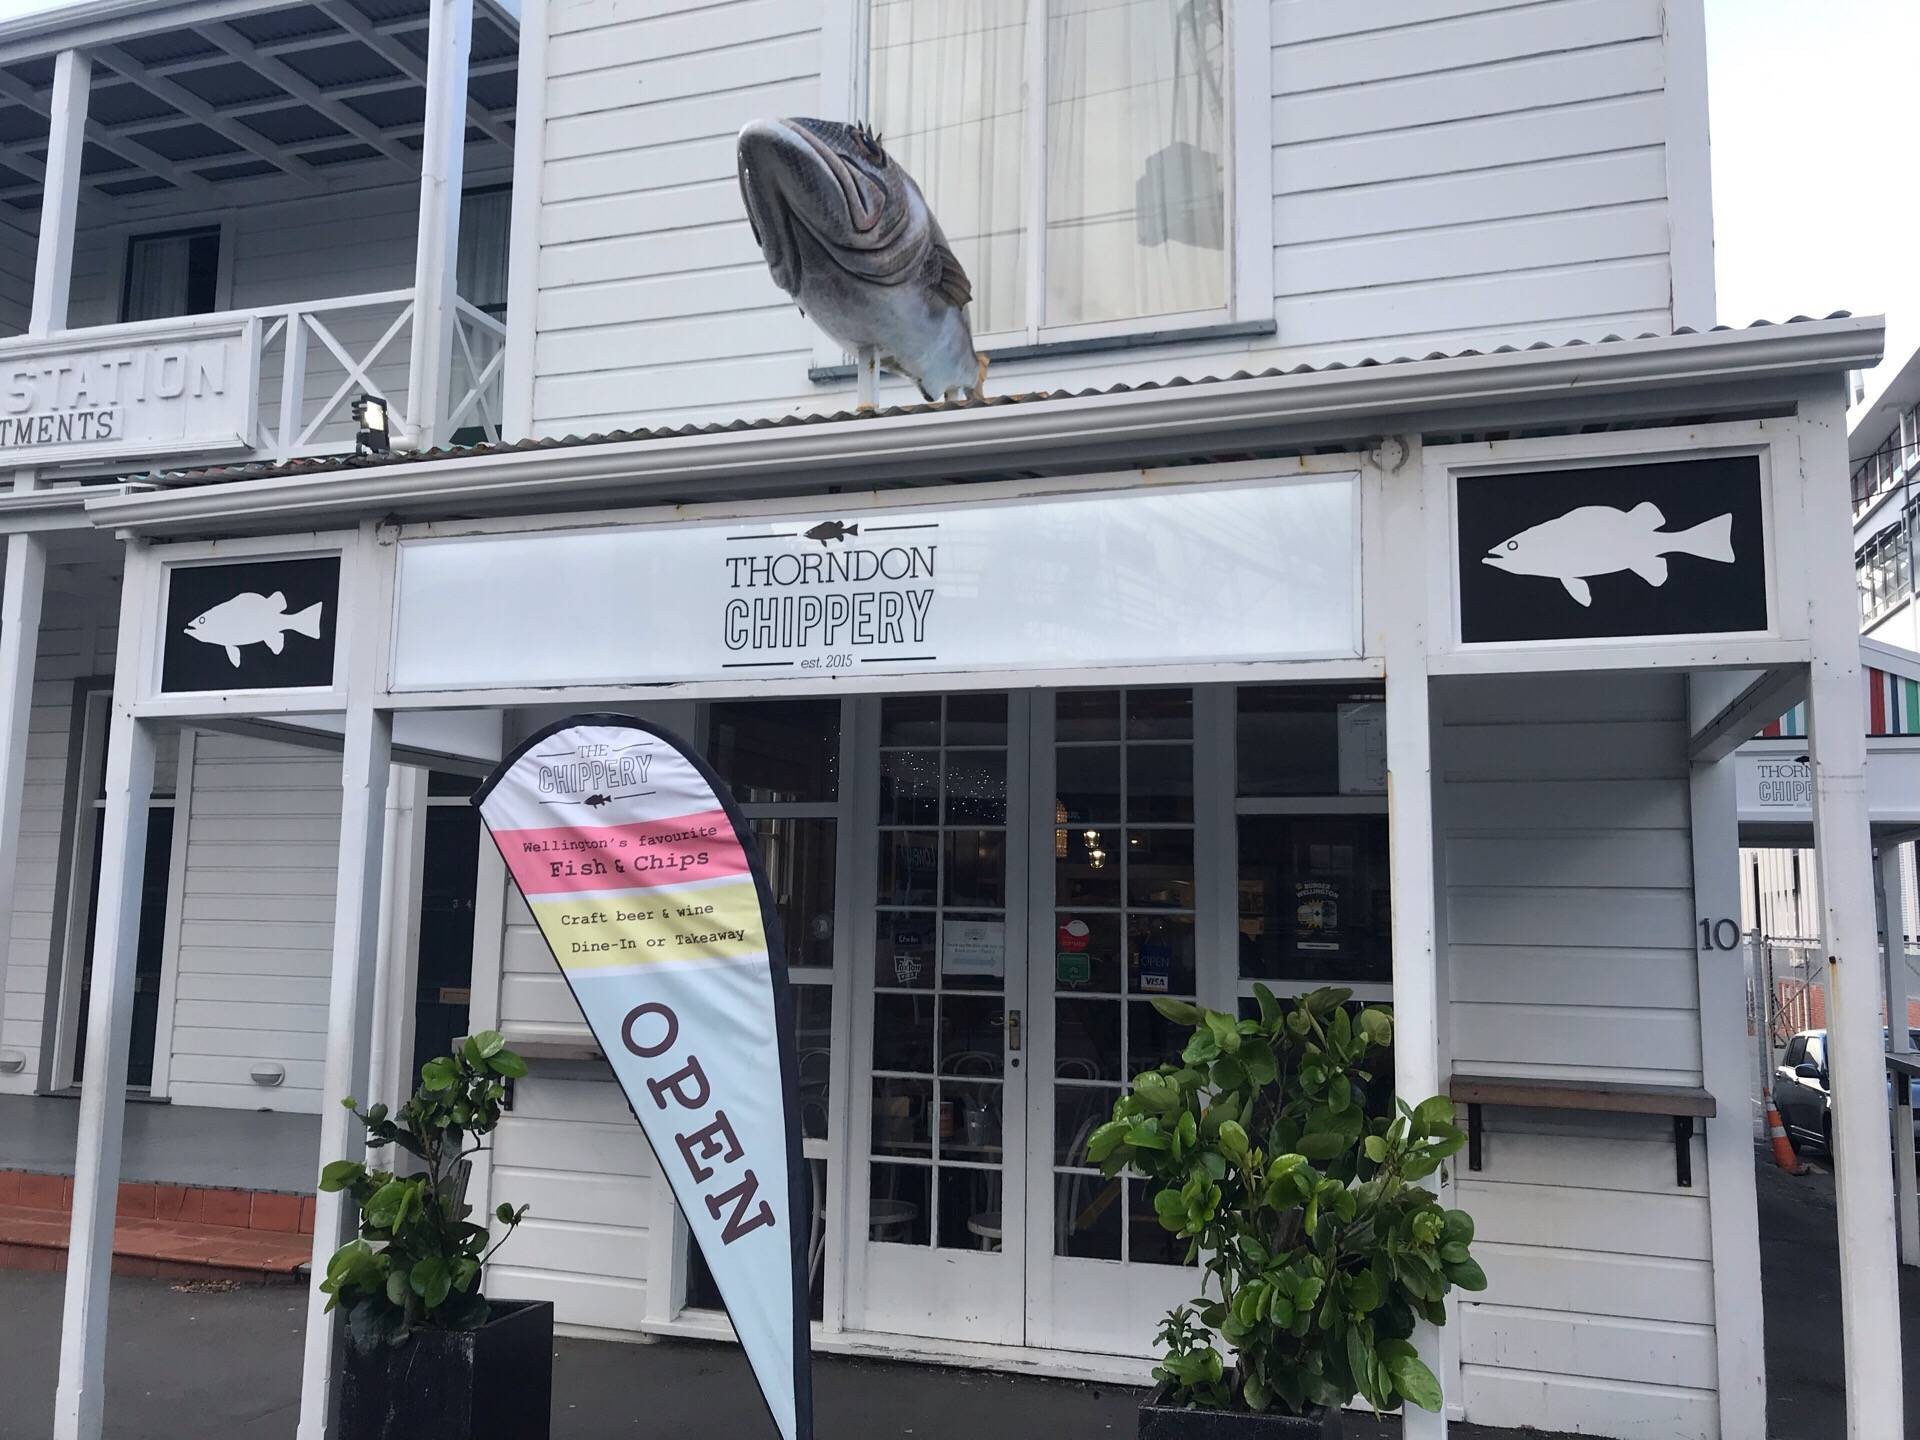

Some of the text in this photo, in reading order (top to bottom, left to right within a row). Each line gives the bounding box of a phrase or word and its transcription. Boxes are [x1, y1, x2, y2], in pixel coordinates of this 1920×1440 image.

[3, 343, 227, 414] STATION
[0, 410, 114, 447] TMENTS
[726, 546, 937, 588] THORNDON
[724, 589, 934, 650] CHIPPERY
[800, 654, 853, 669] est. 2015
[577, 744, 609, 759] THE
[538, 754, 653, 794] CHIPPERY
[522, 825, 718, 853] Wellington's favourite
[550, 851, 710, 878] Fish & Chips
[561, 903, 714, 926] Craft beer & wine
[571, 928, 745, 953] Dine-In or Takeaway
[1699, 918, 1741, 951] 10
[1146, 977, 1165, 986] VISA
[621, 1002, 776, 1246] OPEN
